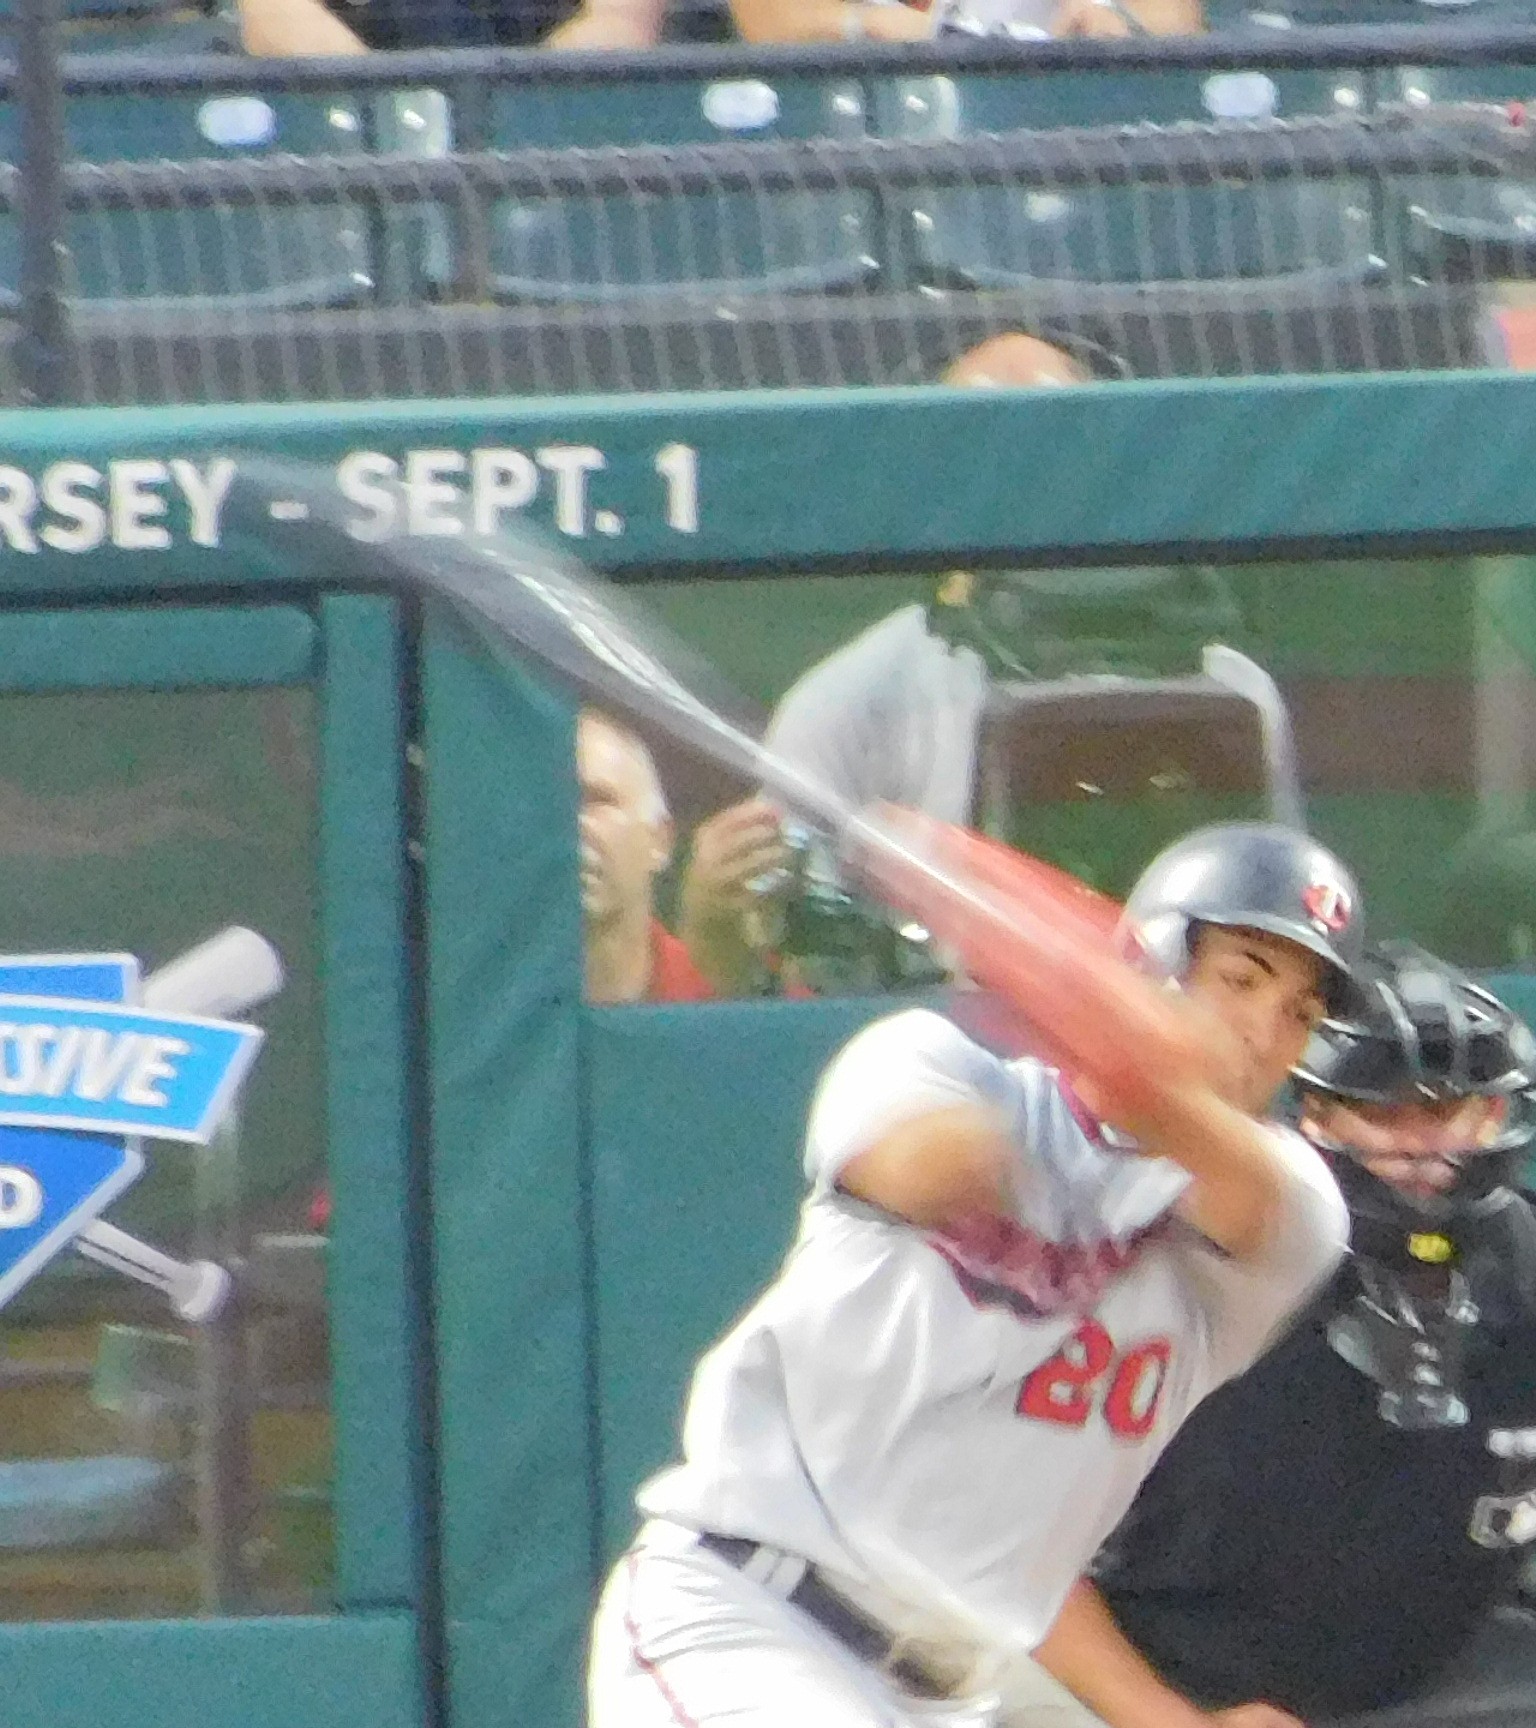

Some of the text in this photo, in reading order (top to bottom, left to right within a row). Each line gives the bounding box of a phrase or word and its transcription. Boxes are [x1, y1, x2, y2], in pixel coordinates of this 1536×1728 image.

[0, 456, 237, 555] RSEY
[336, 444, 625, 543] SEPT.
[655, 440, 701, 534] 1
[1014, 1312, 1172, 1439] 20
